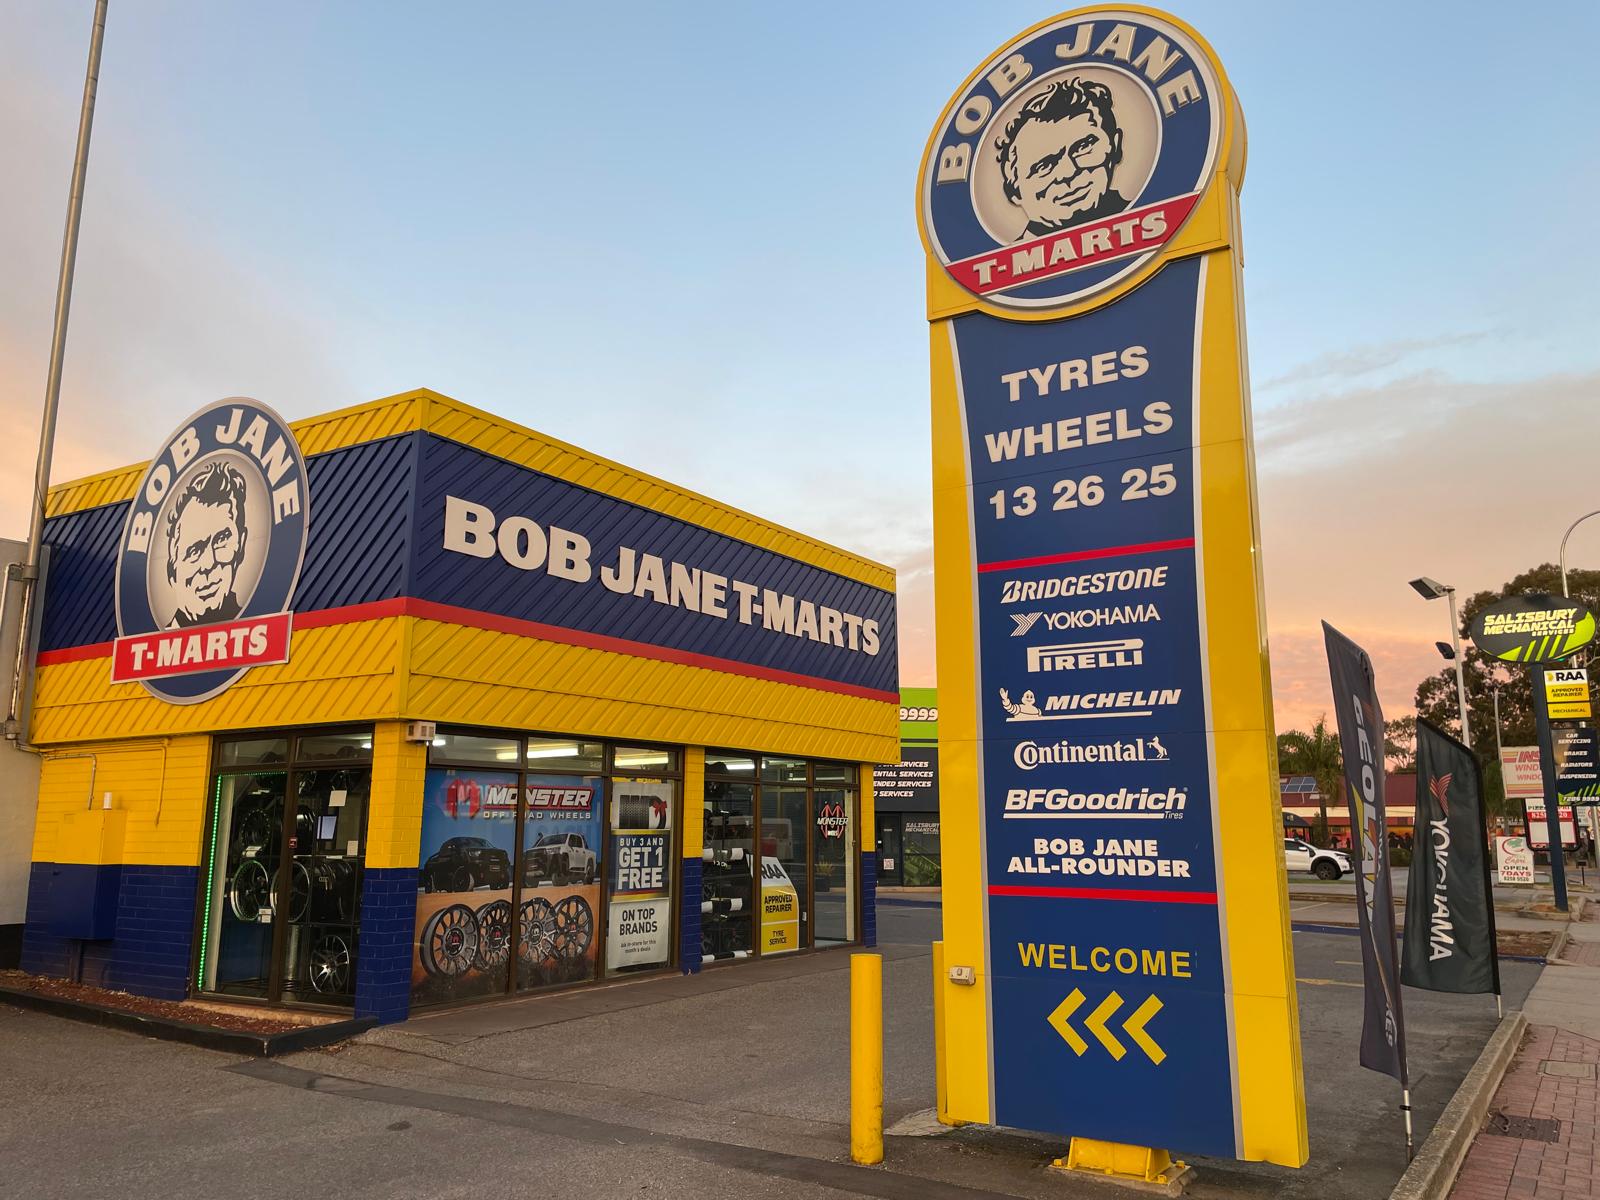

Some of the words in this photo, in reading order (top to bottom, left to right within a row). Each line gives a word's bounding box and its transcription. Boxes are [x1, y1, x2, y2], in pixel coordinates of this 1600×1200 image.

[937, 53, 1034, 186] BOB
[1055, 23, 1202, 118] JANE
[972, 210, 1168, 288] T-MARTS
[1001, 345, 1150, 402] TYRES
[984, 401, 1173, 463] WHEELS
[127, 426, 201, 554] BOB
[215, 408, 300, 525] JANE
[989, 485, 1037, 520] 13
[1052, 475, 1105, 512] 26
[1121, 463, 1177, 501] 25
[443, 495, 592, 583] BOB
[601, 546, 728, 620] JANE
[733, 580, 881, 656] T-MARTS
[1000, 566, 1168, 604] BRIDGESTONE
[1043, 603, 1161, 631] YOKOHAMA
[1484, 608, 1578, 626] SALISBURY
[1484, 620, 1576, 635] MECHANICAL
[130, 624, 268, 671] T-MARTS
[1027, 638, 1144, 673] PIRELLI
[1555, 671, 1585, 681] RAA
[1045, 688, 1182, 711] MICHELIN
[1014, 738, 1146, 771] Continental
[1515, 764, 1539, 773] WIND
[486, 786, 592, 807] MONSTER
[1005, 787, 1187, 810] BFGoodrich
[483, 811, 505, 819] OFF
[550, 811, 591, 819] WHEELS
[1164, 810, 1184, 820] Tires
[620, 838, 636, 847] BUY
[639, 838, 644, 847] 3
[647, 837, 664, 846] AND
[1034, 838, 1085, 855] BOB
[1093, 839, 1159, 857] JANE
[619, 846, 652, 868] GET
[655, 846, 663, 867] 1
[1007, 856, 1192, 878] ALL-ROUNDER
[618, 867, 663, 890] FREE
[764, 894, 793, 904] APPROVED
[765, 904, 793, 914] REPAIRER
[622, 910, 636, 922] ON
[637, 908, 656, 920] TOP
[619, 921, 658, 936] BRANDS
[769, 937, 787, 946] SERVICE
[1017, 942, 1192, 978] WELCOME
